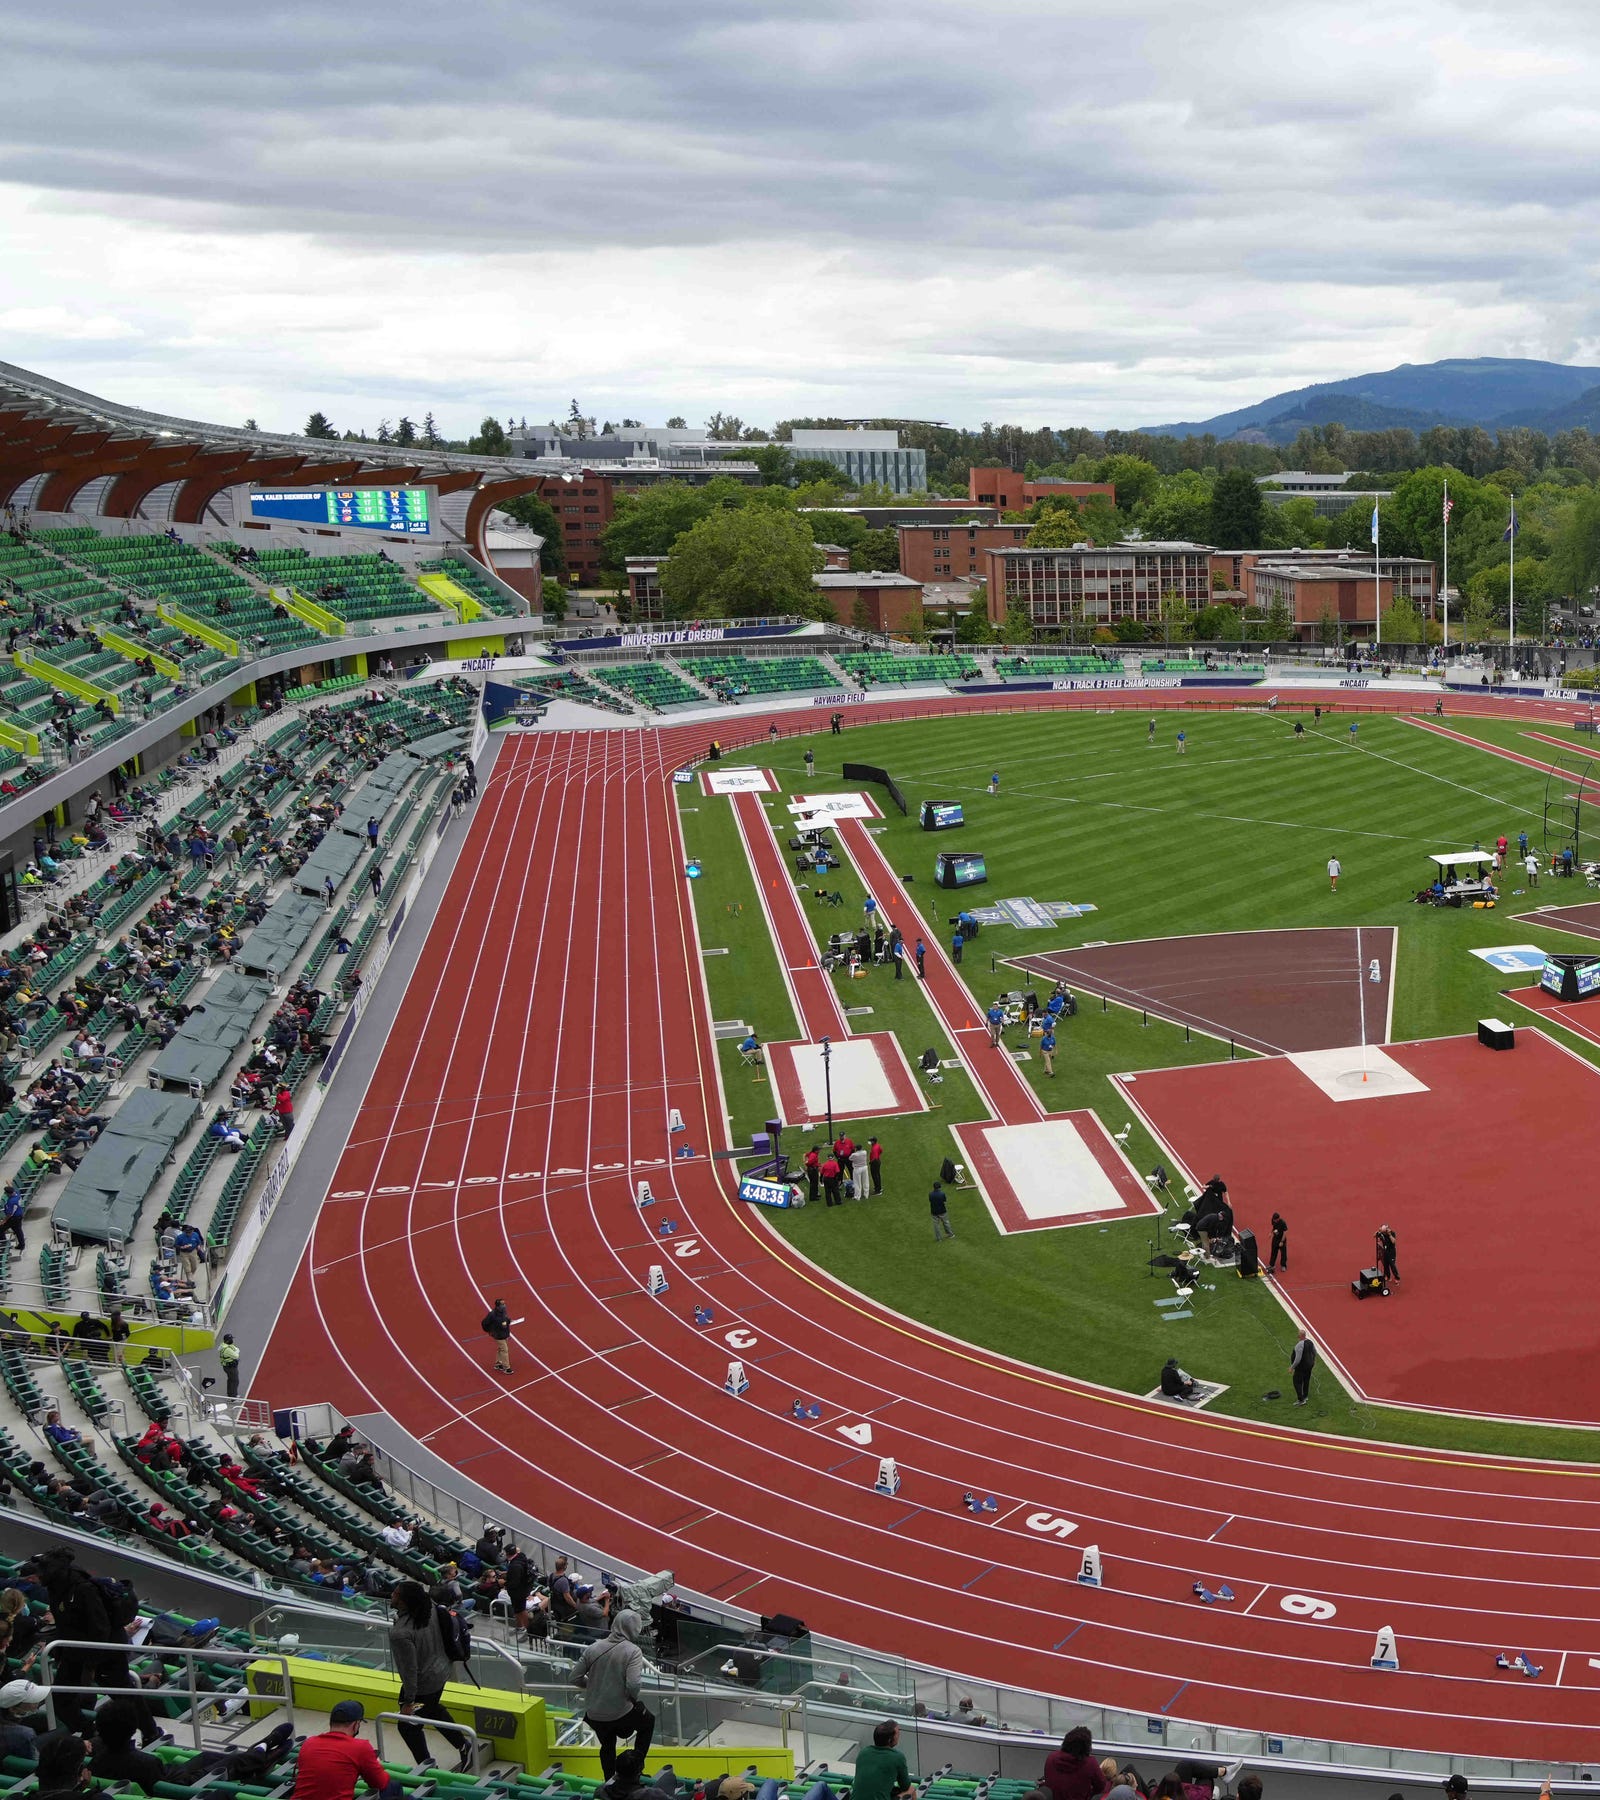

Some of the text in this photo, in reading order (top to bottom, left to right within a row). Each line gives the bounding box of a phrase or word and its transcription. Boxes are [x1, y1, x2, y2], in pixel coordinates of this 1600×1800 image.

[621, 628, 724, 646] UNIVERSITY OF OREGON
[461, 659, 496, 671] #NCAATF
[1052, 678, 1182, 690] NCAA TRACK & FIELD CHAMPIONSHIPS
[1339, 680, 1369, 688] #NCAATF
[814, 692, 865, 706] HAYWARD FIELD
[1544, 689, 1578, 700] NCAA.COM
[277, 1147, 289, 1187] FIELD
[592, 1162, 624, 1170] 3
[634, 1158, 666, 1166] 2
[464, 1176, 498, 1184] 6
[508, 1172, 542, 1180] 5
[376, 1186, 410, 1194] 8
[421, 1180, 456, 1188] 7
[331, 1190, 366, 1198] 9
[644, 1190, 650, 1200] 2
[742, 1185, 784, 1204] 4:48:35
[674, 1239, 700, 1258] 2
[657, 1274, 664, 1286] 3
[724, 1329, 758, 1349] 3
[728, 1374, 733, 1385] 4
[738, 1372, 745, 1383] 4
[836, 1422, 872, 1445] 4
[880, 1471, 888, 1486] 5
[1025, 1512, 1080, 1538] 5
[1084, 1560, 1092, 1576] 6
[1280, 1594, 1336, 1620] 6
[1380, 1643, 1389, 1658] 7
[484, 1715, 506, 1732] 217
